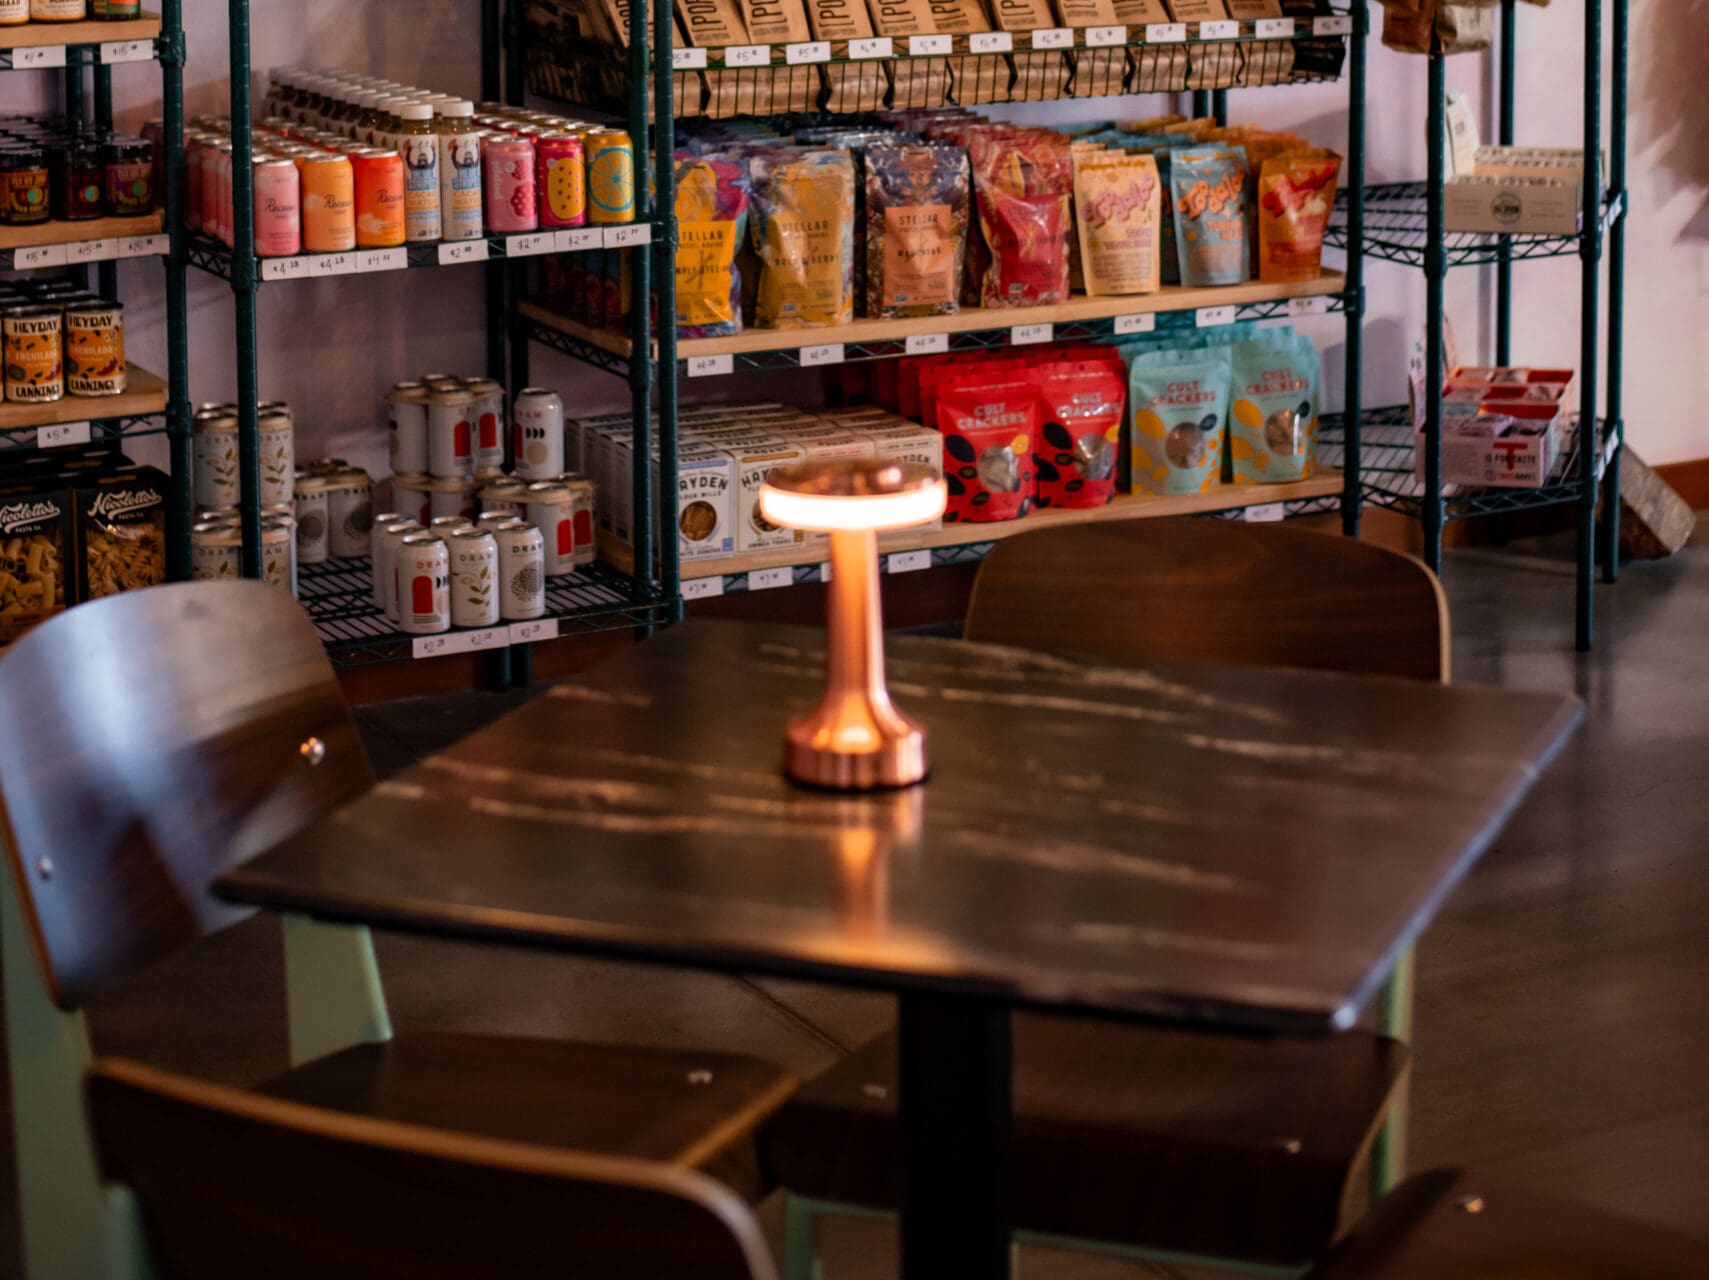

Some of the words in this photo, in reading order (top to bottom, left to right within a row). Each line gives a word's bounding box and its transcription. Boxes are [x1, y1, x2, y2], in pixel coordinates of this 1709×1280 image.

[682, 230, 723, 241] TELLAR
[14, 320, 58, 333] HEYDAY
[69, 314, 114, 329] HEYDAY
[1261, 368, 1292, 382] CULT
[1168, 380, 1200, 393] CULT
[1245, 379, 1310, 396] CRACKERS
[1072, 392, 1103, 404] CULT
[1149, 391, 1217, 407] CRACKERS
[974, 402, 1005, 417] CULT
[957, 413, 1027, 430] CRACKERS
[679, 476, 728, 491] AYDEN
[680, 492, 698, 500] LOUR
